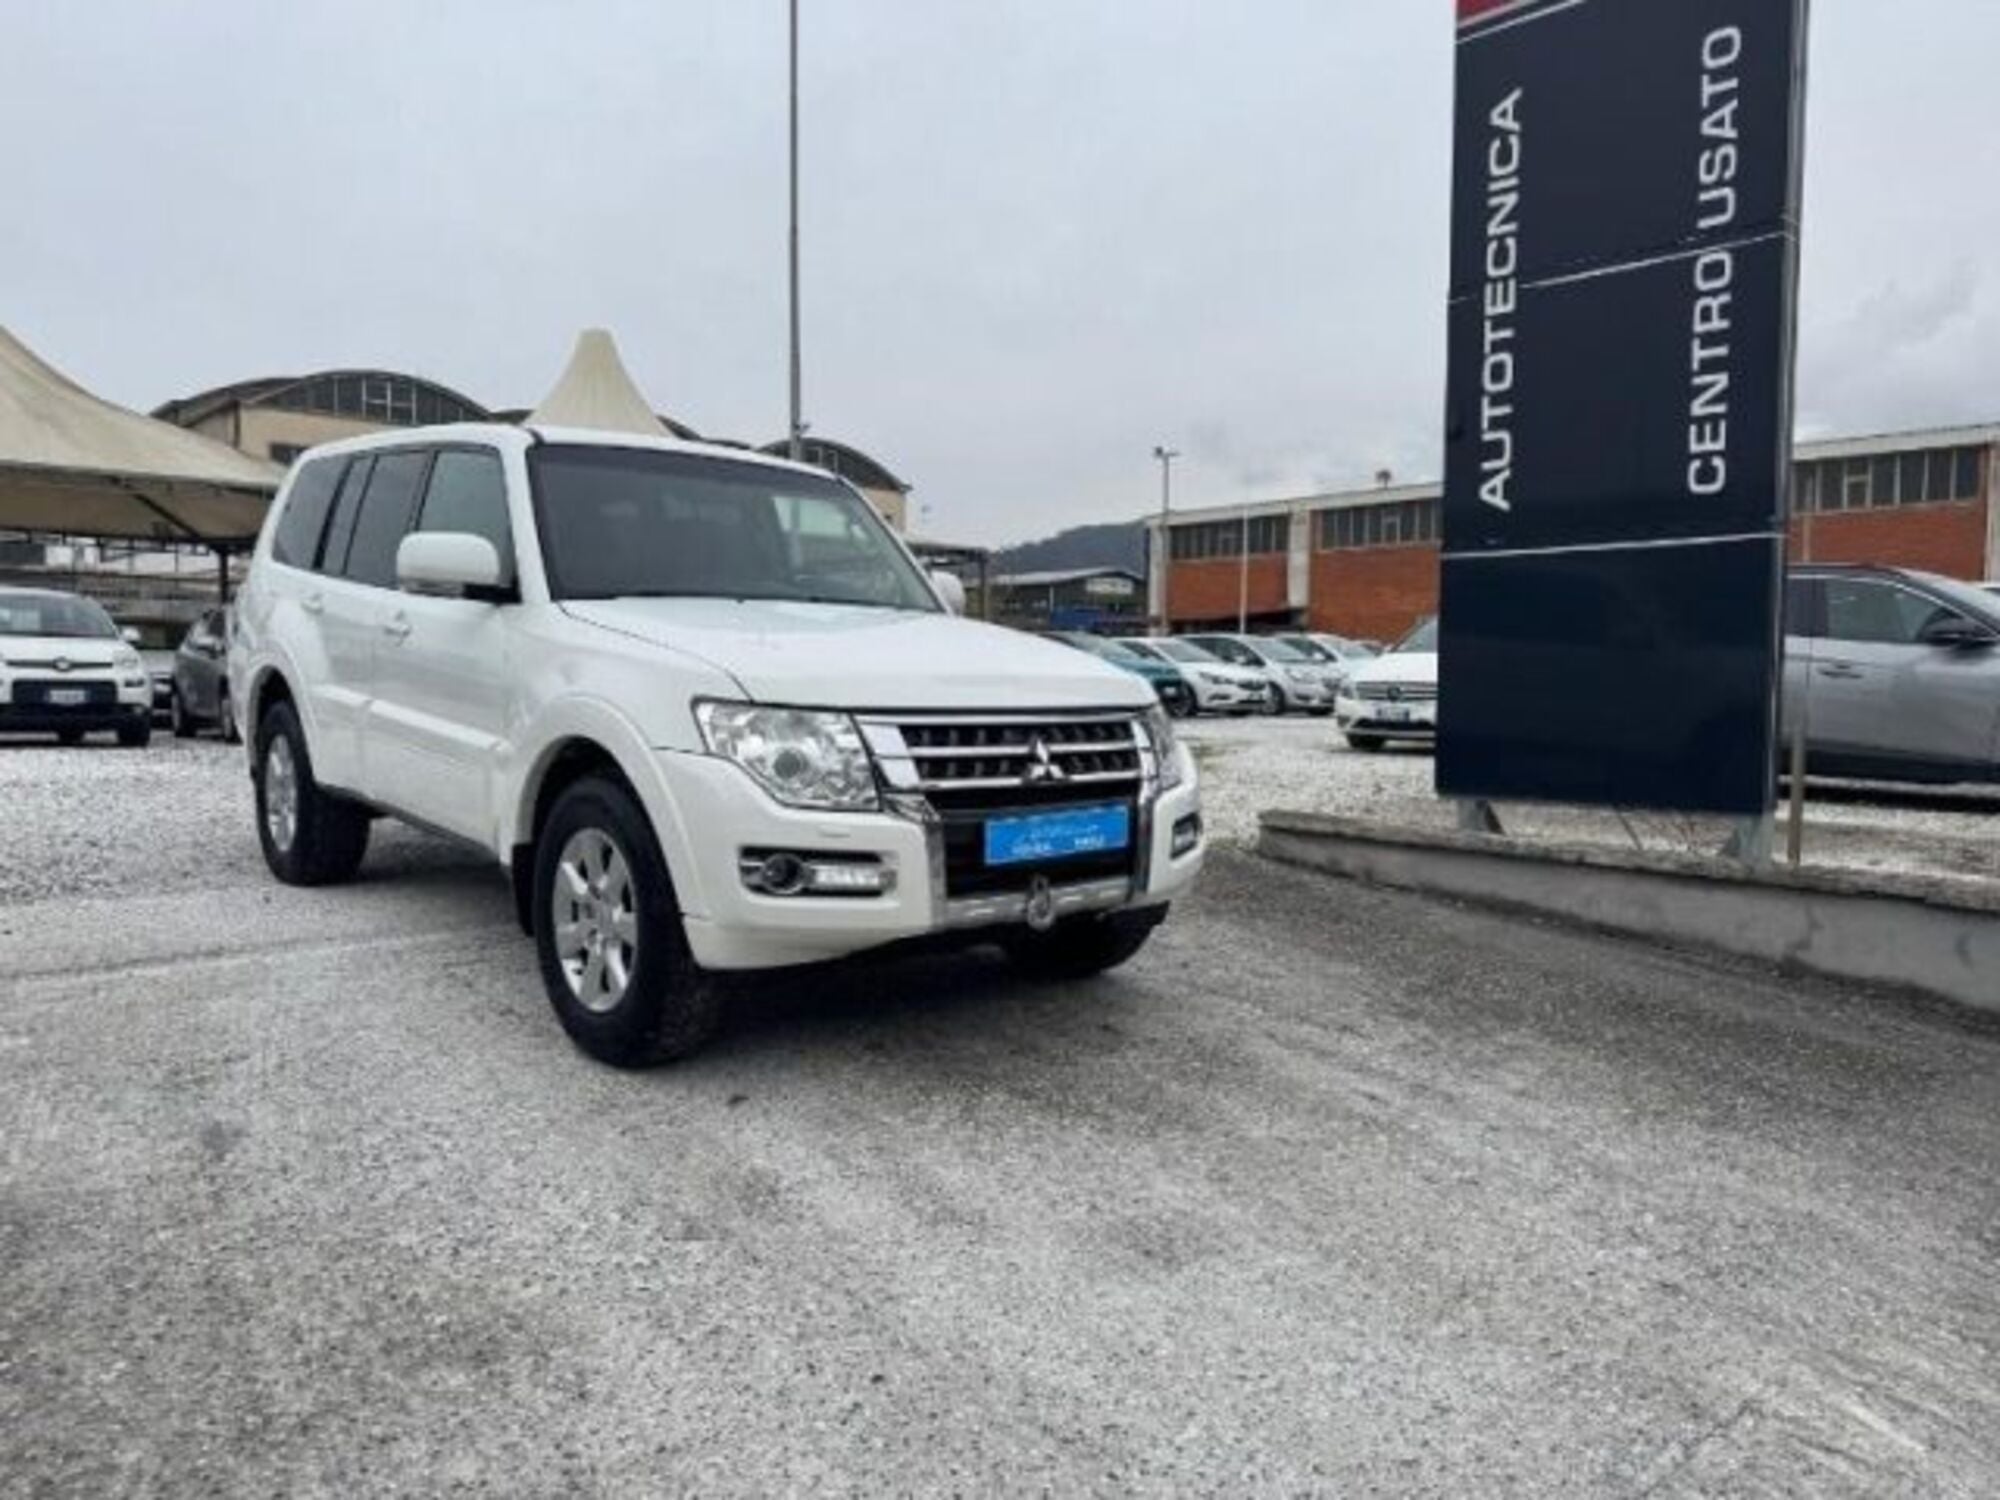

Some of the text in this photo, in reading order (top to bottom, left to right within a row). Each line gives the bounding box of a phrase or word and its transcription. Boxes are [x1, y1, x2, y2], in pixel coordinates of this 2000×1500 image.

[1479, 87, 1523, 511] AUTOTECNICA
[1687, 26, 1742, 495] CENTRO USATO
